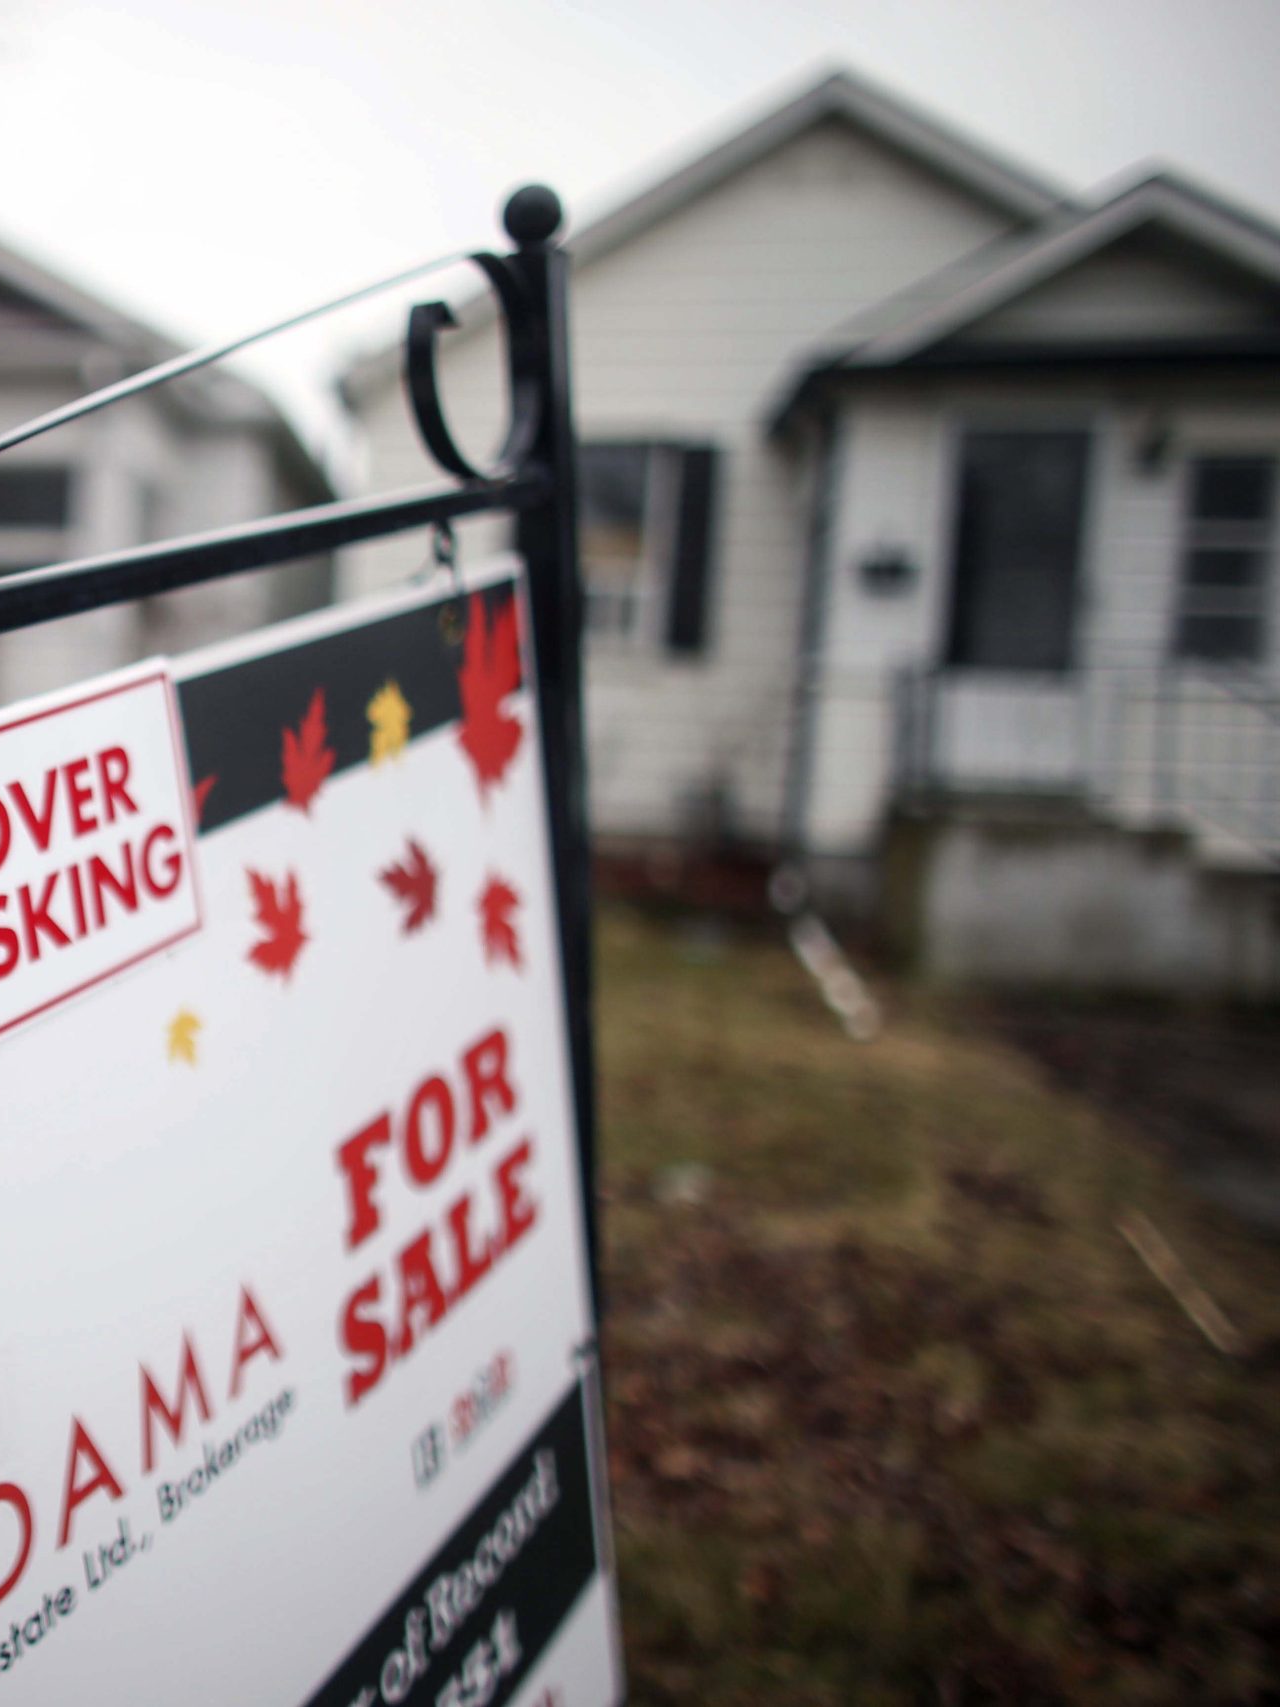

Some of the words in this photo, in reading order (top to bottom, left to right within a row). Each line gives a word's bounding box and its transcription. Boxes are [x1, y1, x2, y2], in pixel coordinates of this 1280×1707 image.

[336, 1027, 517, 1250] FOR
[342, 1138, 539, 1406] SALE
[157, 1386, 296, 1525] Brokerage
[381, 1607, 429, 1705] of
[426, 1449, 560, 1651] Record
